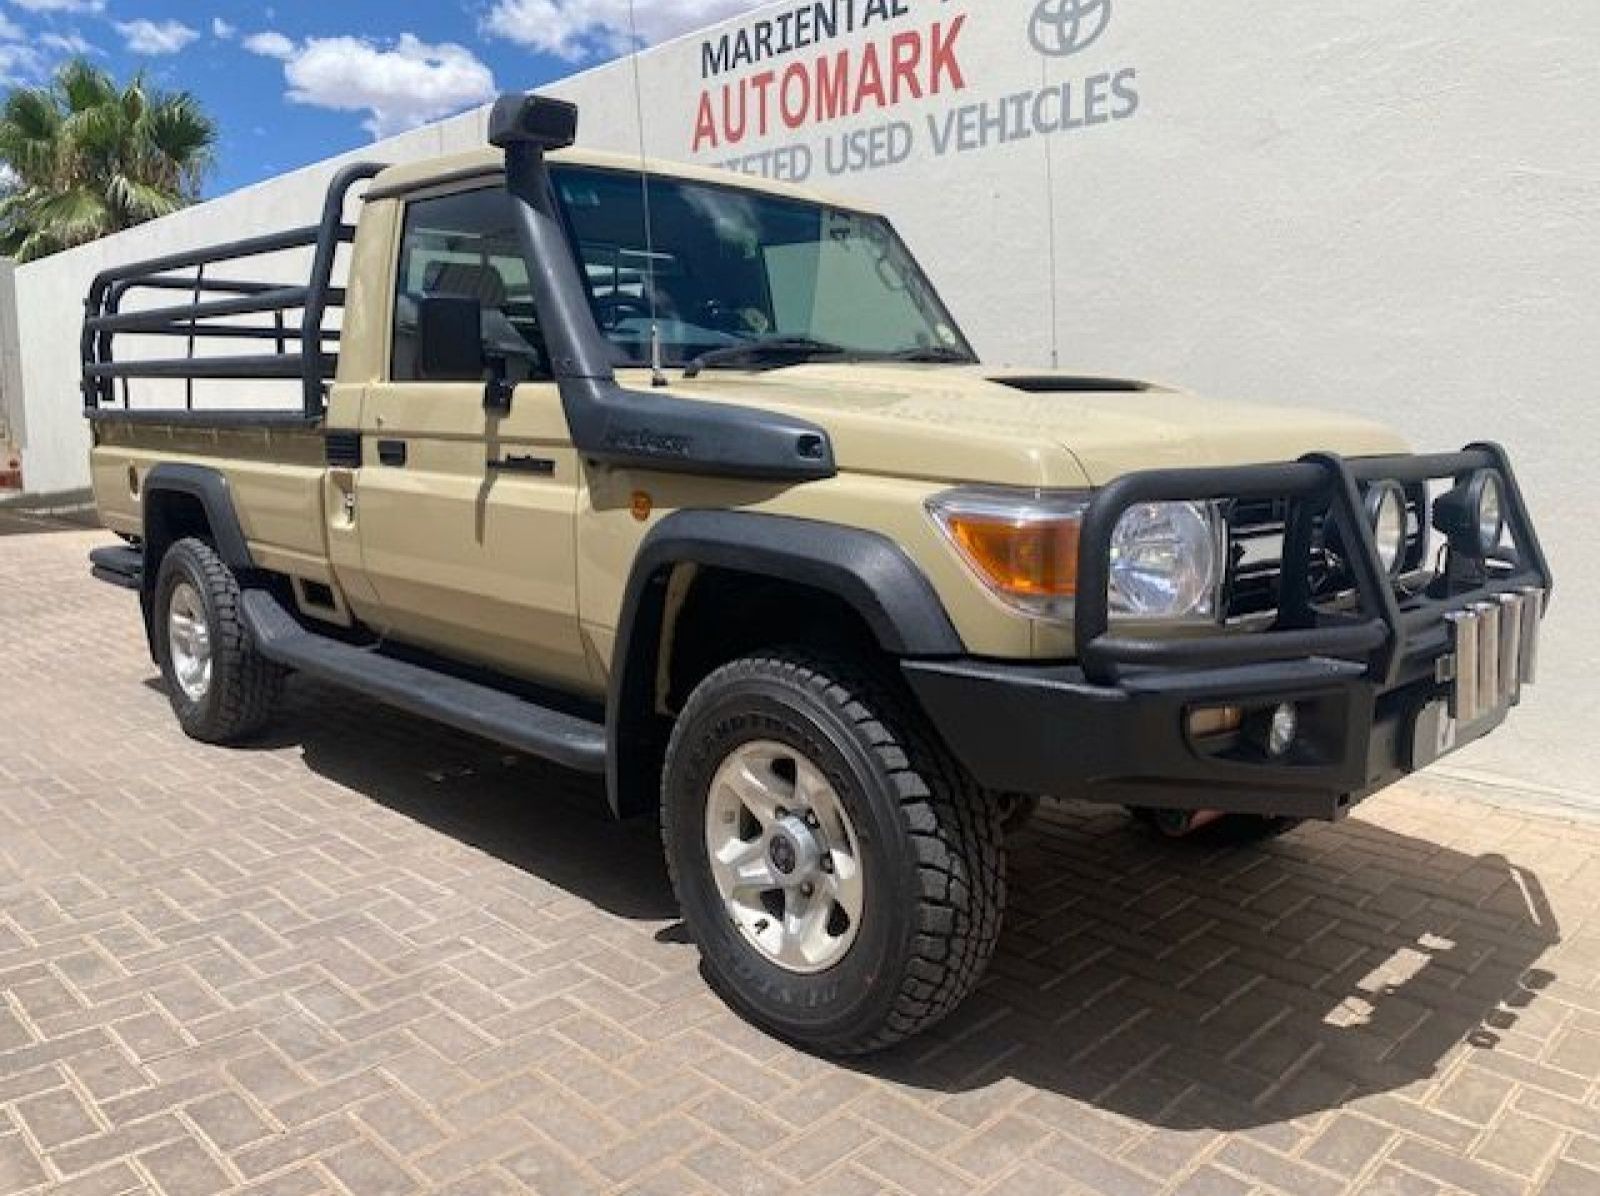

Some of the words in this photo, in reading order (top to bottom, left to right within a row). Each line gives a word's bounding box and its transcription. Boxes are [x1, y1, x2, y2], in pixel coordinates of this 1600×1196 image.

[692, 13, 967, 153] AUTOMARK
[825, 120, 913, 176] USED
[926, 67, 1140, 156] VEHICLES
